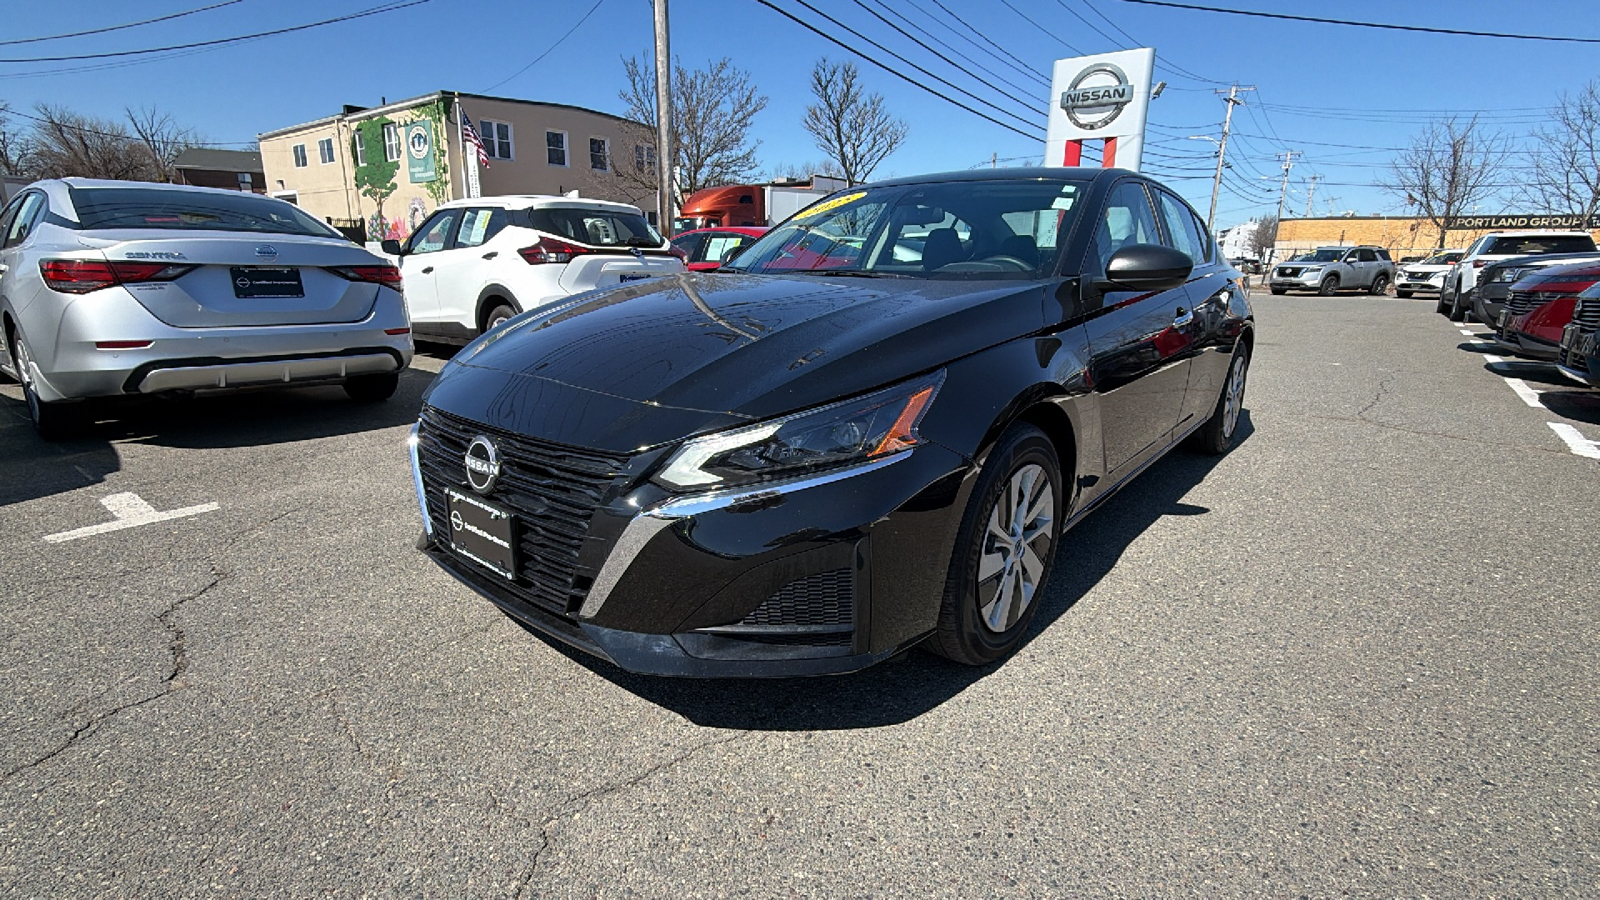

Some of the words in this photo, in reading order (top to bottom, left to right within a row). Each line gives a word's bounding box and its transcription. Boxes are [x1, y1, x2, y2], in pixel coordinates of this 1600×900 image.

[1066, 88, 1126, 103] NISSAN
[1455, 217, 1528, 227] PORTLAND
[1529, 216, 1582, 226] GROUP
[125, 251, 188, 260] SENTRA
[465, 456, 499, 475] NISSAN
